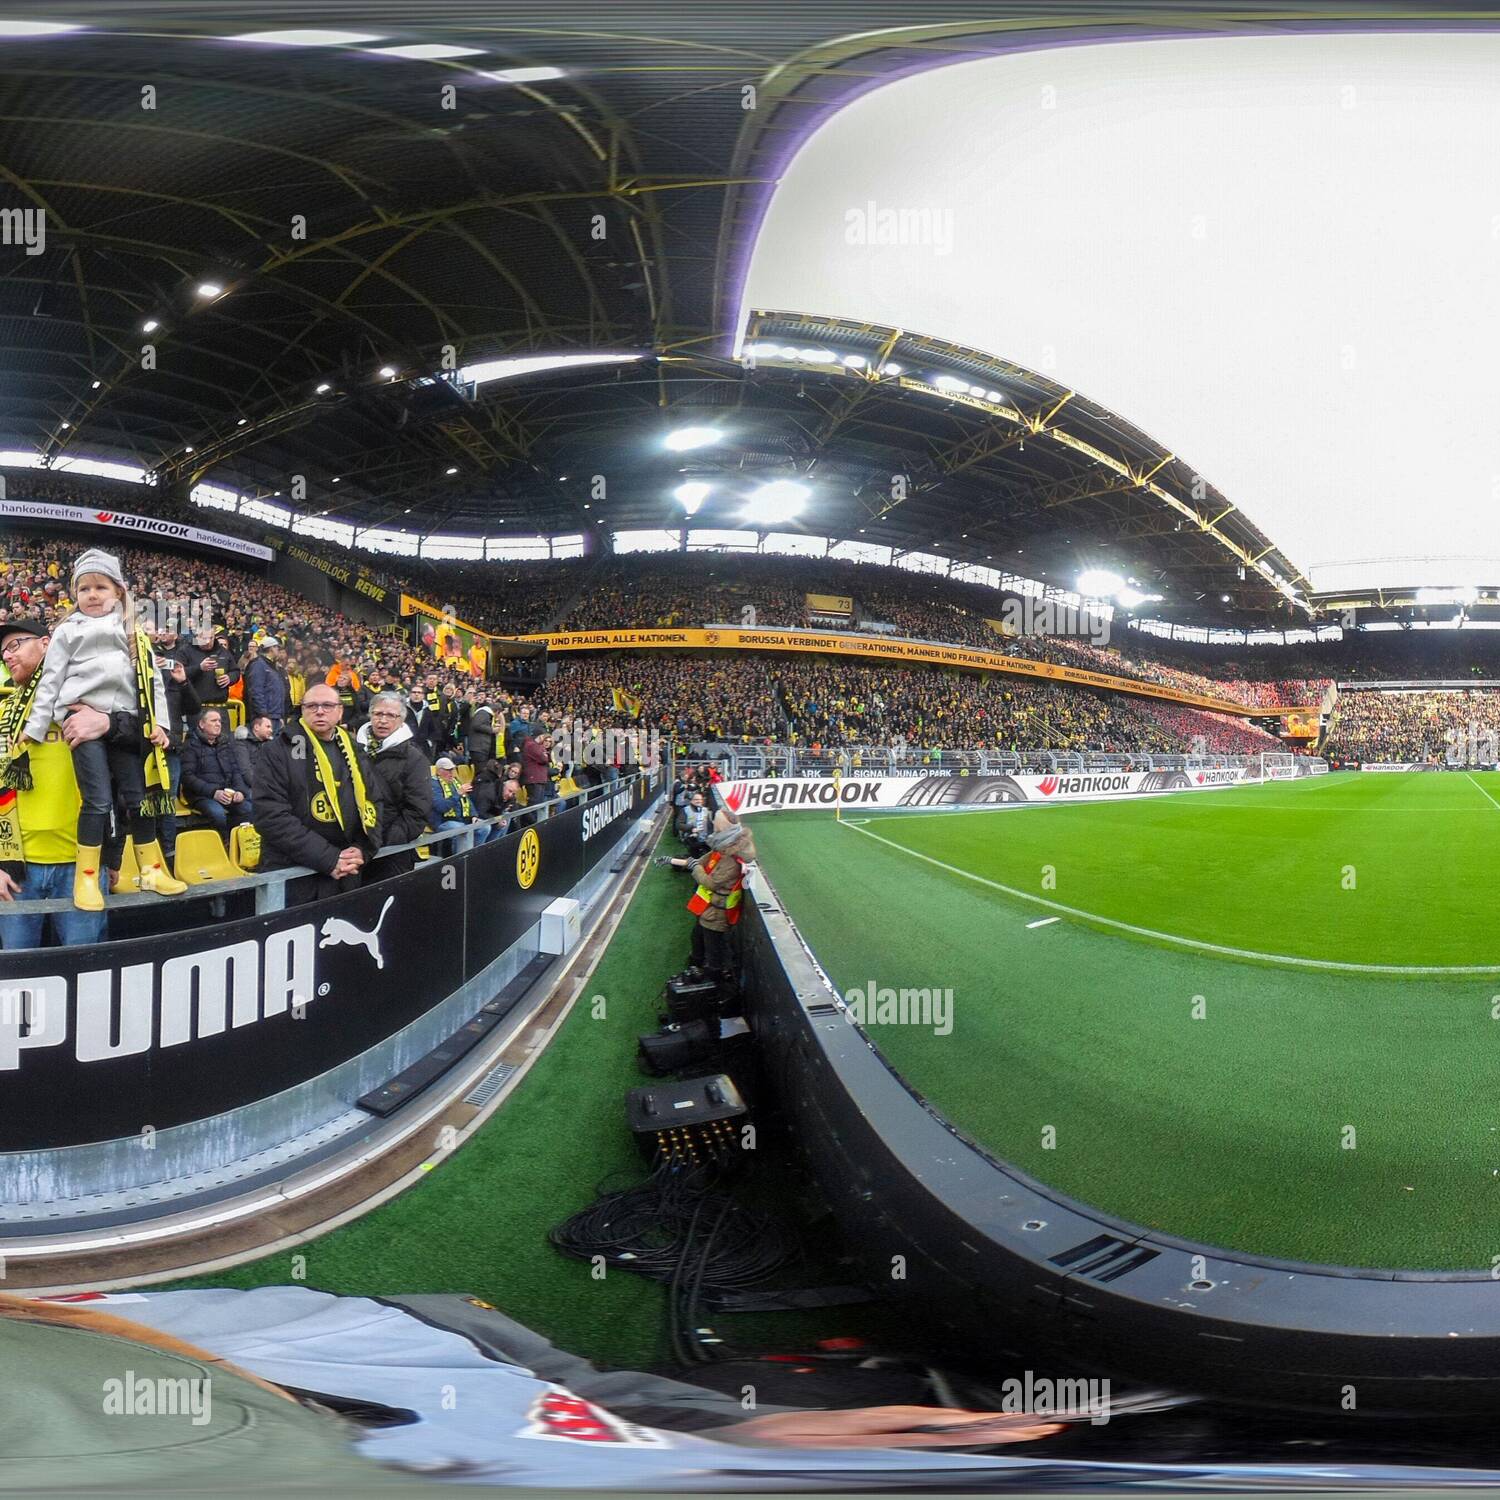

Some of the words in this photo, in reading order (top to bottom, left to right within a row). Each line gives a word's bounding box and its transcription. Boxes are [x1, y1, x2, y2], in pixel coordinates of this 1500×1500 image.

[1, 503, 83, 519] hankookreifen
[287, 546, 351, 583] FAMILIENBLOCK
[355, 578, 387, 603] REWE
[838, 600, 851, 609] 73
[552, 637, 570, 646] UND
[572, 635, 611, 646] FRAUEN,
[613, 634, 637, 643] ALLE
[639, 633, 688, 643] NATIONEN.
[738, 634, 785, 645] BORUSSIA
[787, 637, 837, 649] VERBINDET
[942, 650, 958, 660] UND
[854, 769, 888, 778] SIGNAL
[929, 769, 952, 778] PARK
[582, 797, 613, 842] SIGNAL
[521, 834, 537, 873] BVB
[0, 923, 316, 1071] PUMA
